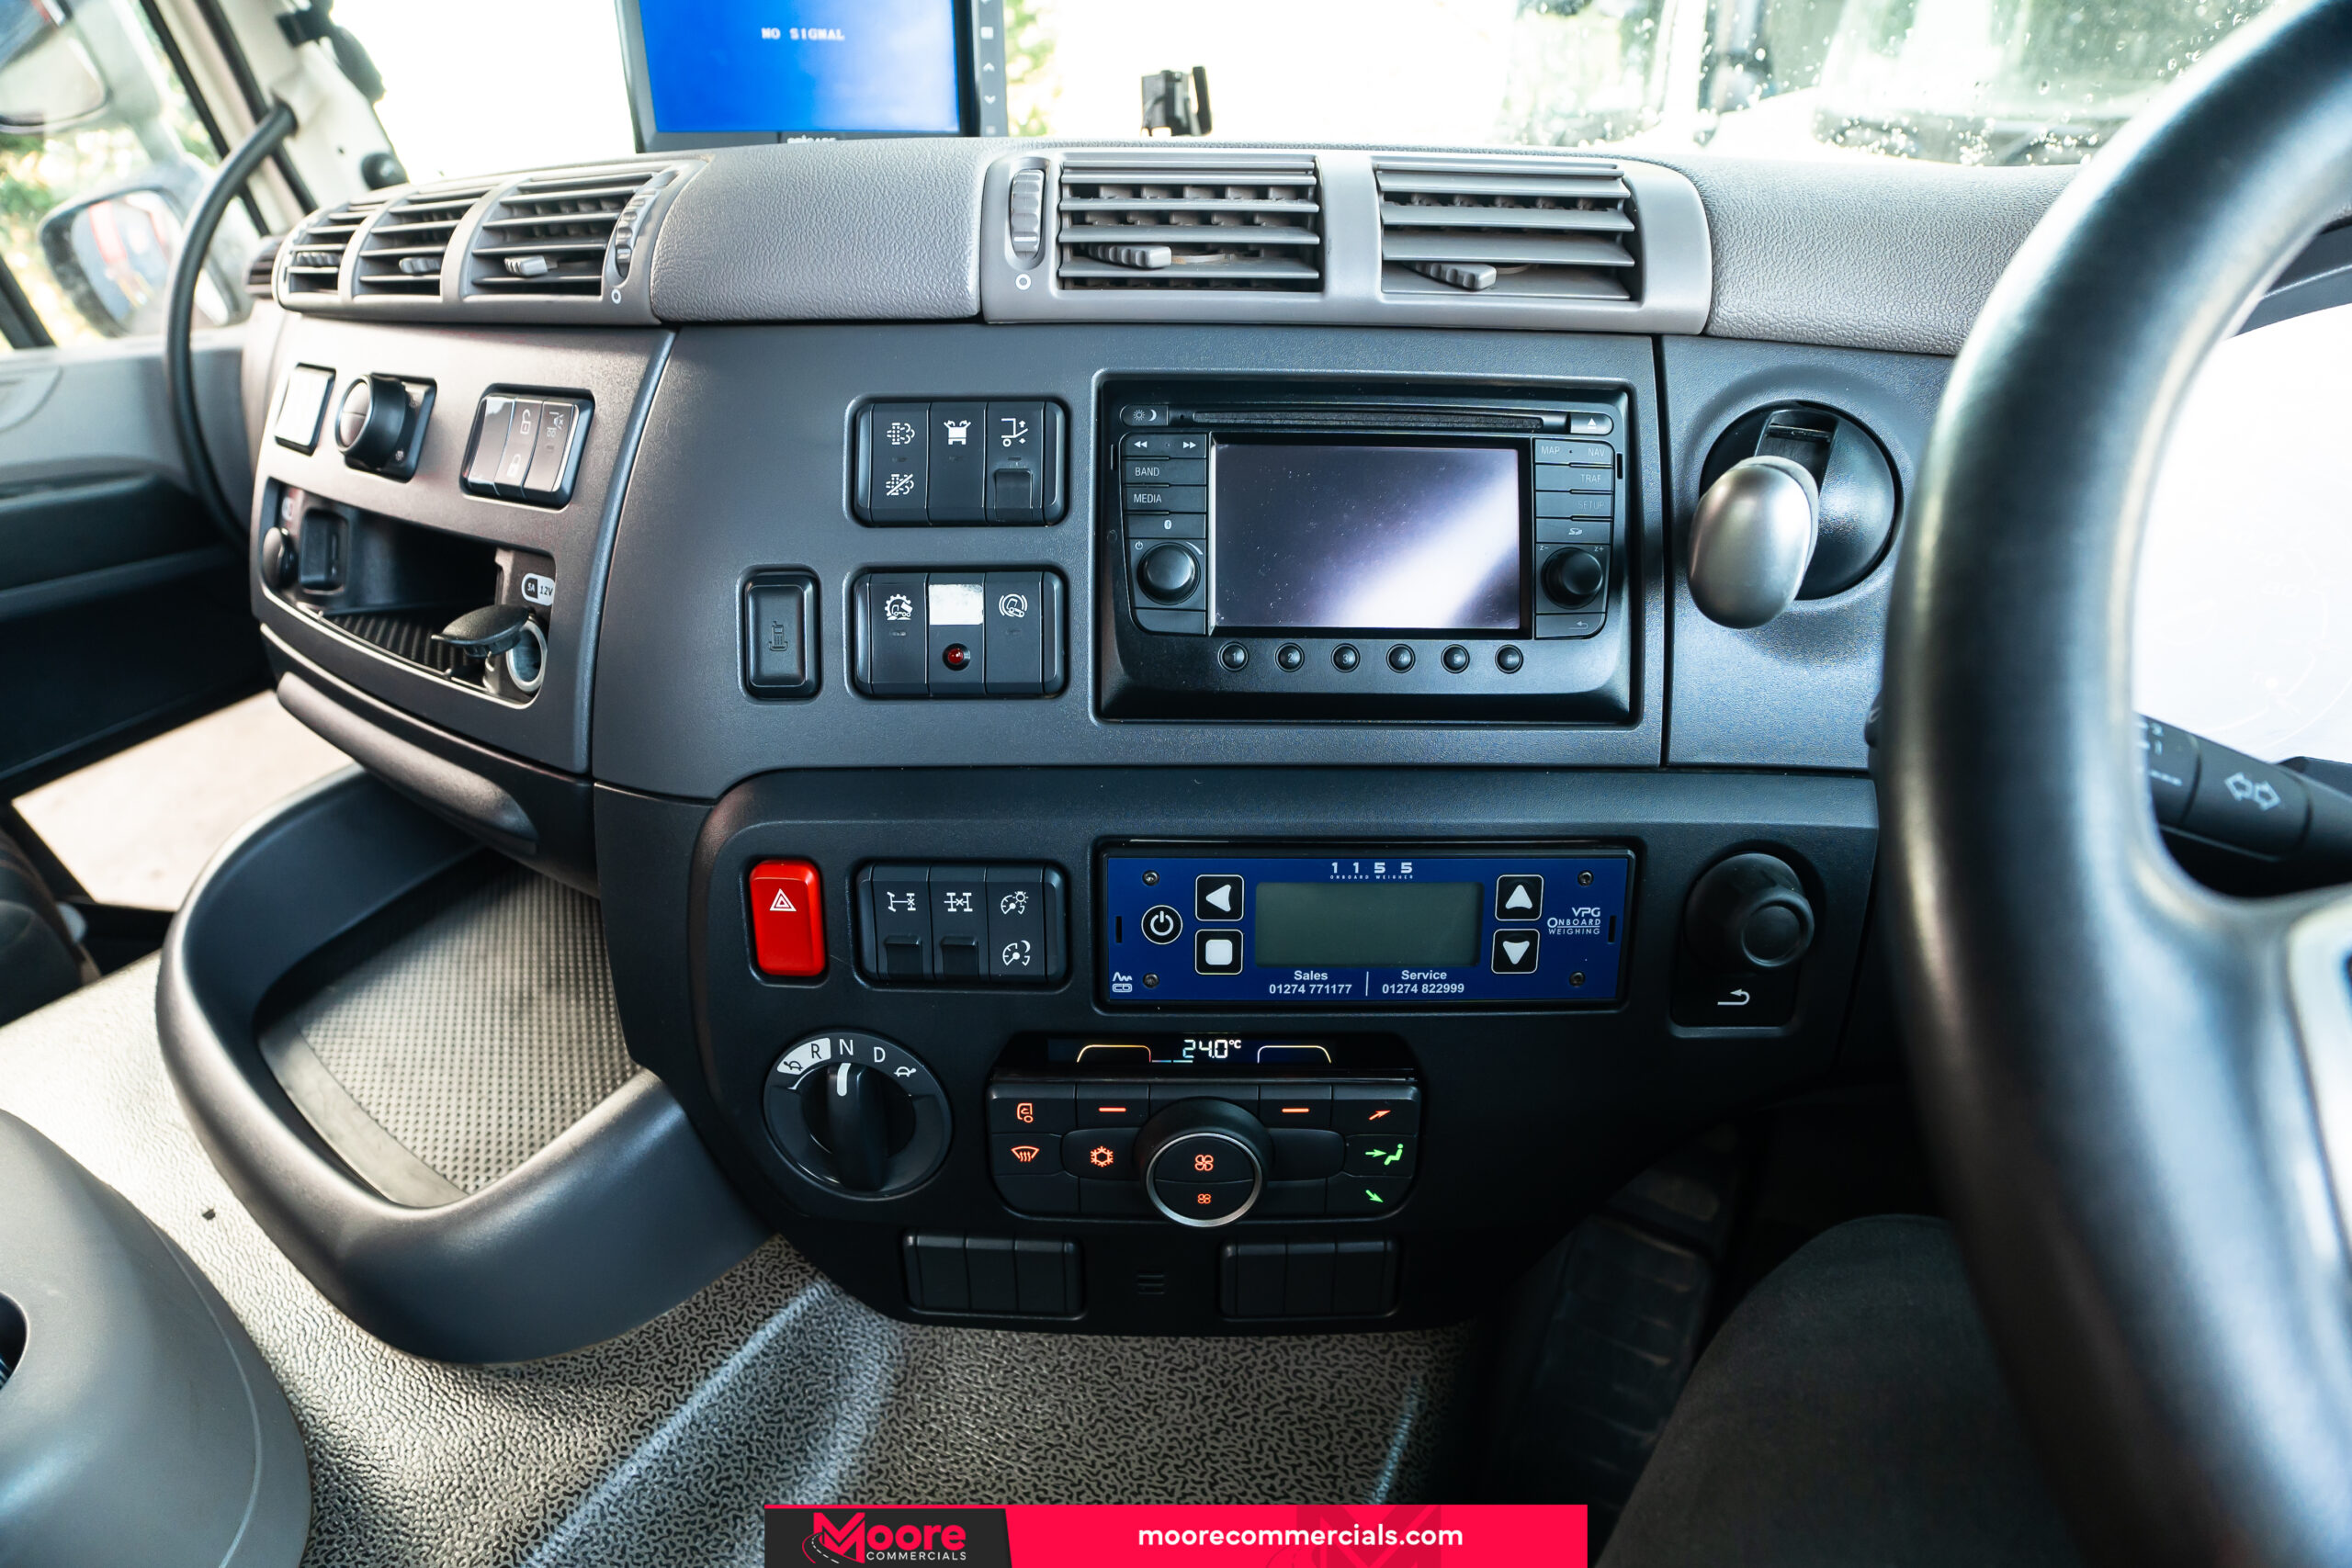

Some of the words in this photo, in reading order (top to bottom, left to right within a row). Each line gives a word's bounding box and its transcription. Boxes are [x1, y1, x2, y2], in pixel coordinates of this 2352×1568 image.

[761, 27, 781, 39] NO
[789, 27, 845, 41] SIGNAL
[1541, 446, 1560, 455] MAP
[1588, 447, 1606, 457] NAV
[1135, 467, 1160, 477] BAND
[1580, 473, 1602, 483] TRAF
[1133, 493, 1162, 503] MEDIA
[539, 585, 554, 597] 12V
[1288, 652, 1294, 663] 2
[1342, 654, 1348, 664] 3
[1398, 653, 1405, 662] 4
[1572, 907, 1601, 918] VPG
[1294, 970, 1329, 981] Sales
[1401, 969, 1447, 980] Service
[1269, 984, 1306, 994] 01274
[1309, 984, 1352, 994] 771177
[1382, 983, 1419, 994] 01274
[1421, 983, 1464, 994] 822999
[810, 1043, 822, 1059] R
[839, 1038, 854, 1055] N
[873, 1046, 886, 1063] D
